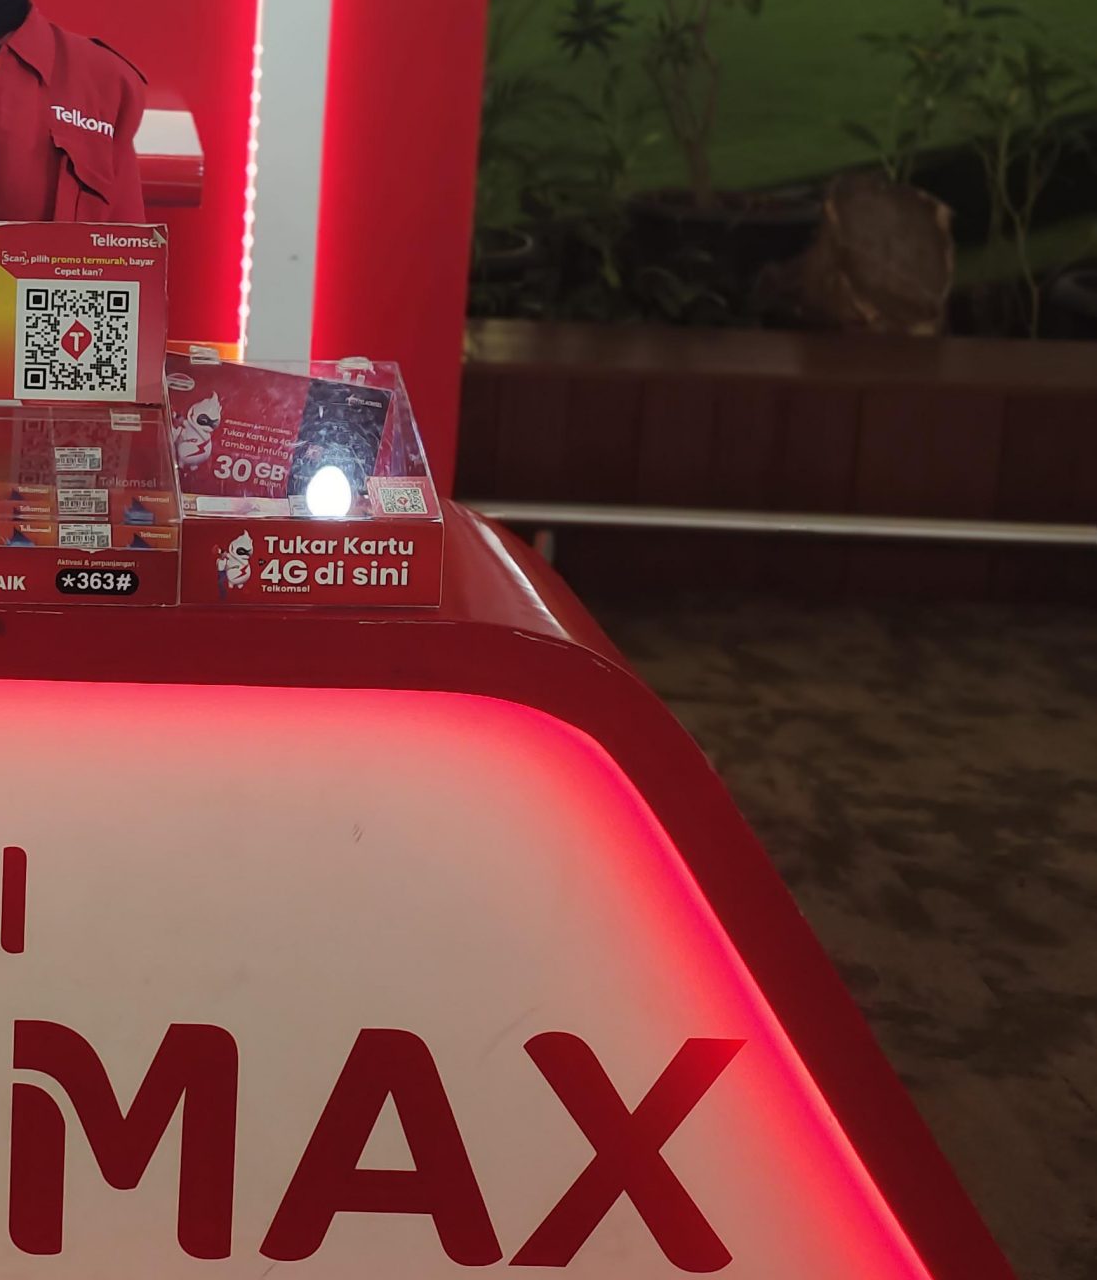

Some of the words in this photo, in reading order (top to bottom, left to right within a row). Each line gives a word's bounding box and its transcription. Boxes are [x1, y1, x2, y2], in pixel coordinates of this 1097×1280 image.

[50, 105, 115, 139] Telkom
[31, 255, 50, 264] pilih
[51, 256, 81, 265] promo
[83, 256, 128, 266] termurah,
[129, 257, 154, 266] bayar
[55, 267, 80, 276] Cepet
[82, 268, 103, 277] kan?
[223, 428, 245, 438] Tukar
[246, 432, 268, 442] Kartu
[268, 436, 278, 444] ke
[221, 440, 255, 452] Tambah
[213, 455, 252, 482] 30
[255, 462, 285, 481] GB
[264, 536, 338, 555] Tukar
[343, 537, 414, 556] Kartu
[57, 558, 82, 566] Aktivasi
[260, 558, 308, 584] 4G
[314, 560, 344, 585] di
[352, 561, 409, 586] sini
[261, 584, 310, 593] Telkomsel
